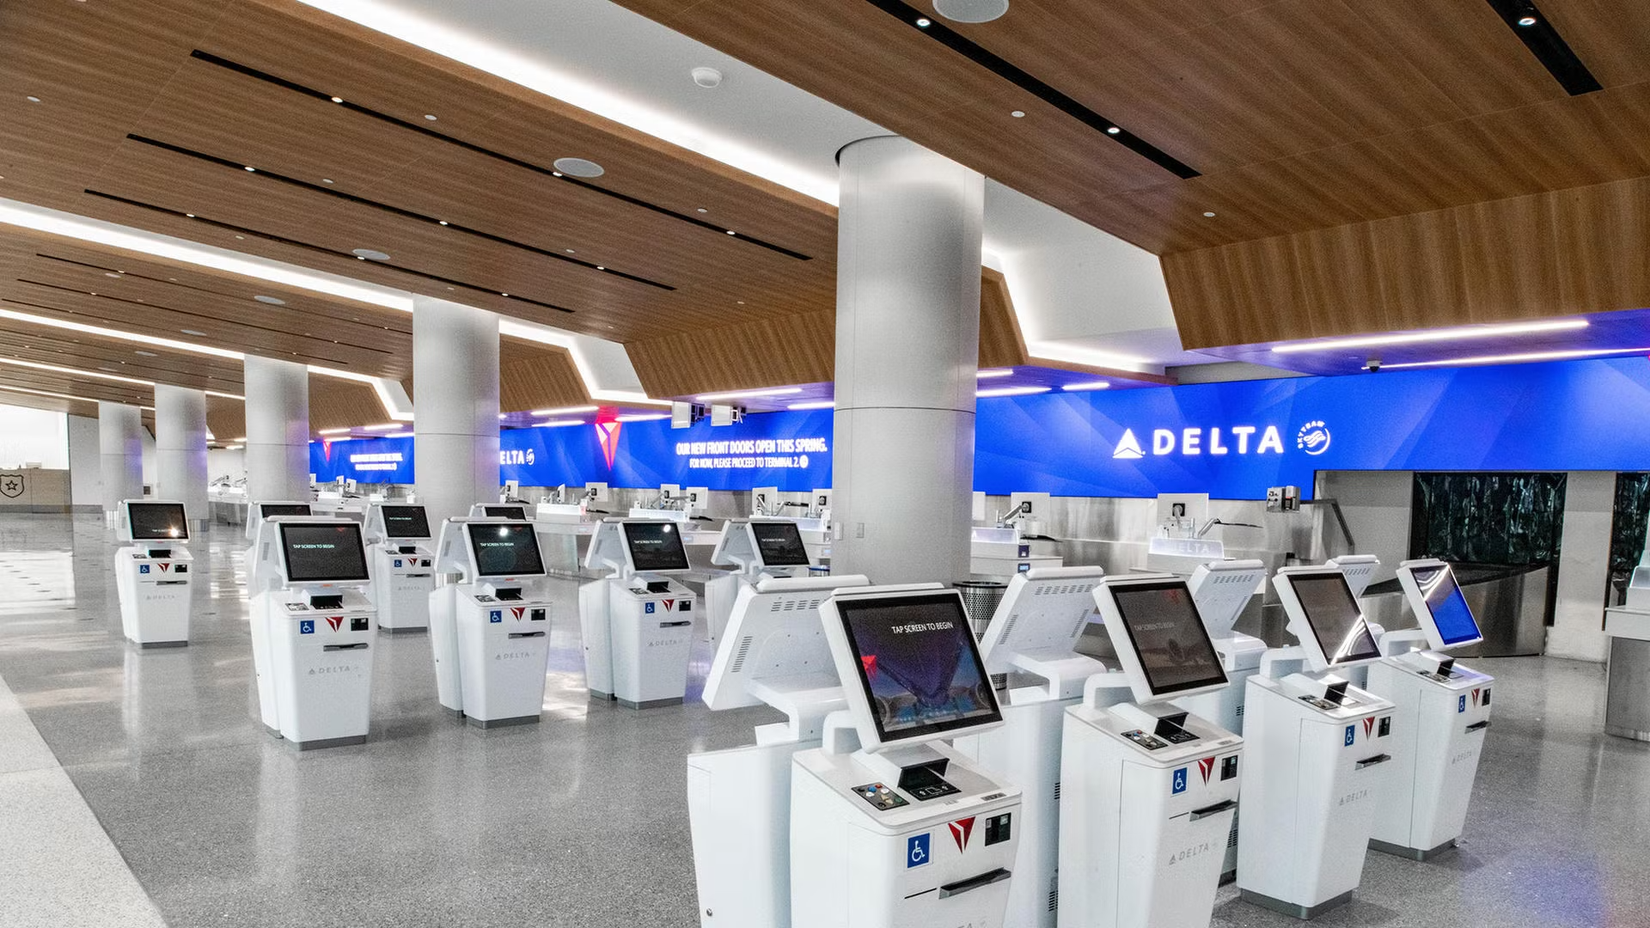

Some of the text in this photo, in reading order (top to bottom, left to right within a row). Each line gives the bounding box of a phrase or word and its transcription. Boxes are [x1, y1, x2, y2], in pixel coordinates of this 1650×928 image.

[676, 437, 828, 455] OUR NEW FRONT DOORS OPEN THIS SPRING.
[1152, 425, 1284, 455] DELTA
[500, 450, 525, 465] ELTA
[690, 458, 700, 468] FOR
[714, 457, 732, 468] PLEASE
[732, 457, 755, 468] PROCEED
[756, 457, 764, 468] TO
[765, 456, 793, 468] TERMINAL
[891, 621, 954, 634] TAP SCREEN TO BEGIN
[319, 665, 350, 674] DELTA
[1178, 843, 1209, 861] DELTA
